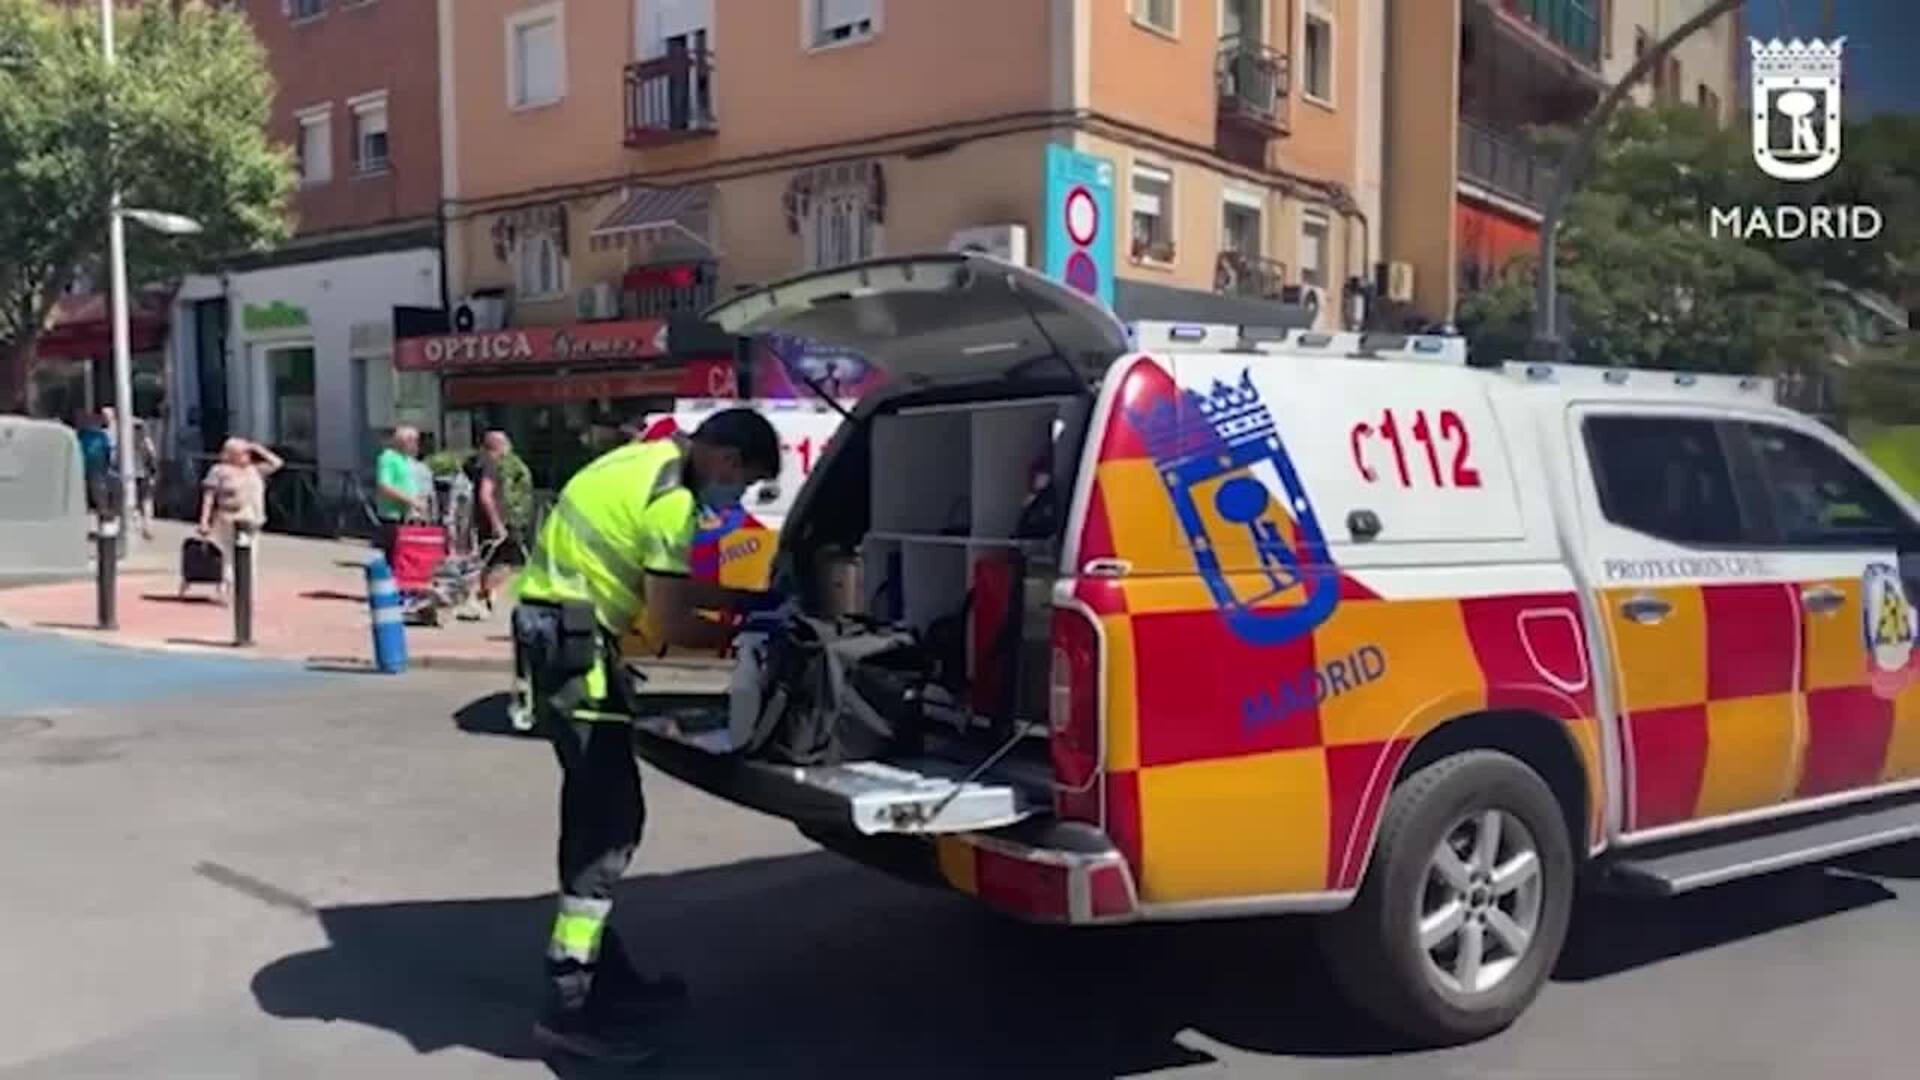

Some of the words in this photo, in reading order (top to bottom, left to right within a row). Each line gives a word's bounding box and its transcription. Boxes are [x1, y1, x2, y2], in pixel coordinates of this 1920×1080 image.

[424, 332, 533, 361] OPTICA
[1379, 407, 1482, 488] 112
[1241, 644, 1385, 737] MADRID
